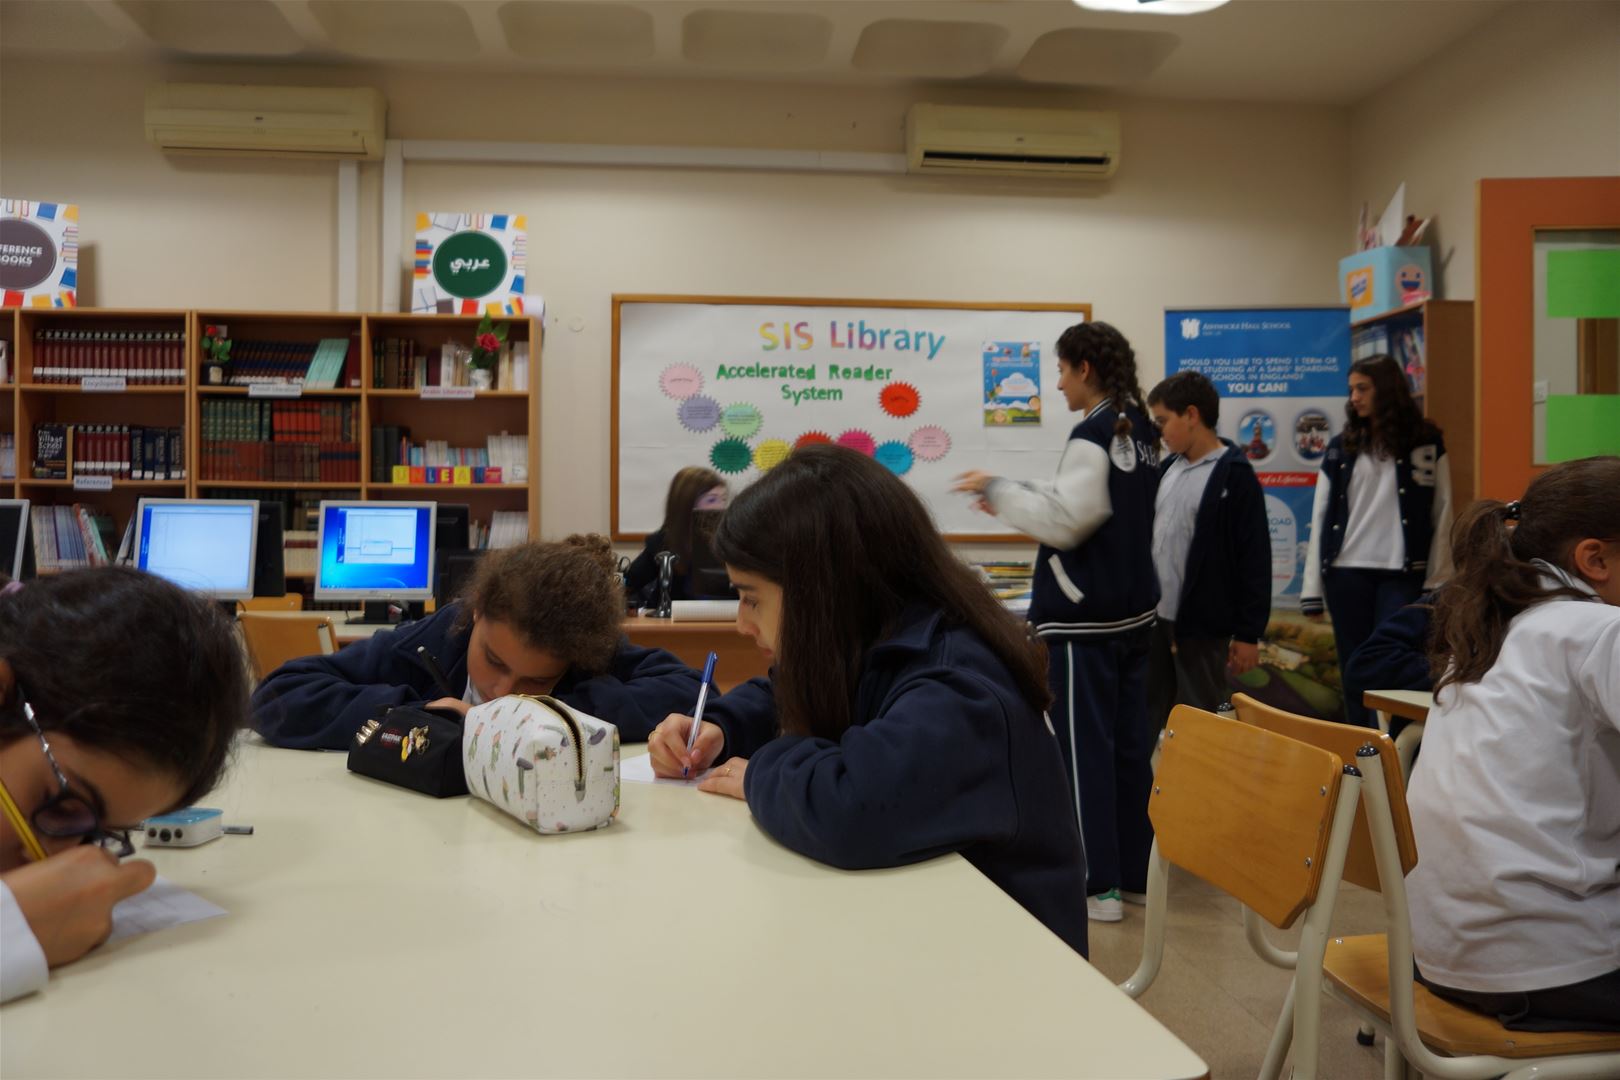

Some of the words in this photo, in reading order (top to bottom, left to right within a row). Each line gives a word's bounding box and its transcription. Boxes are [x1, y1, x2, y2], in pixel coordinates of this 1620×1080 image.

[0, 255, 33, 266] OOKS
[450, 258, 490, 274] عربي
[758, 321, 814, 351] SIS
[830, 320, 946, 360] Library
[1180, 358, 1210, 366] WOULD
[1213, 358, 1230, 366] YOU
[1232, 358, 1248, 366] LIKE
[1251, 357, 1263, 366] TO
[1265, 357, 1292, 365] SPEND
[1325, 357, 1338, 365] OR
[716, 362, 816, 381] Accelerated
[828, 363, 893, 381] Reader
[1211, 373, 1246, 381] SCHOOL
[781, 384, 843, 406] System
[1227, 383, 1255, 394] YOU
[1257, 383, 1288, 393] CAN!
